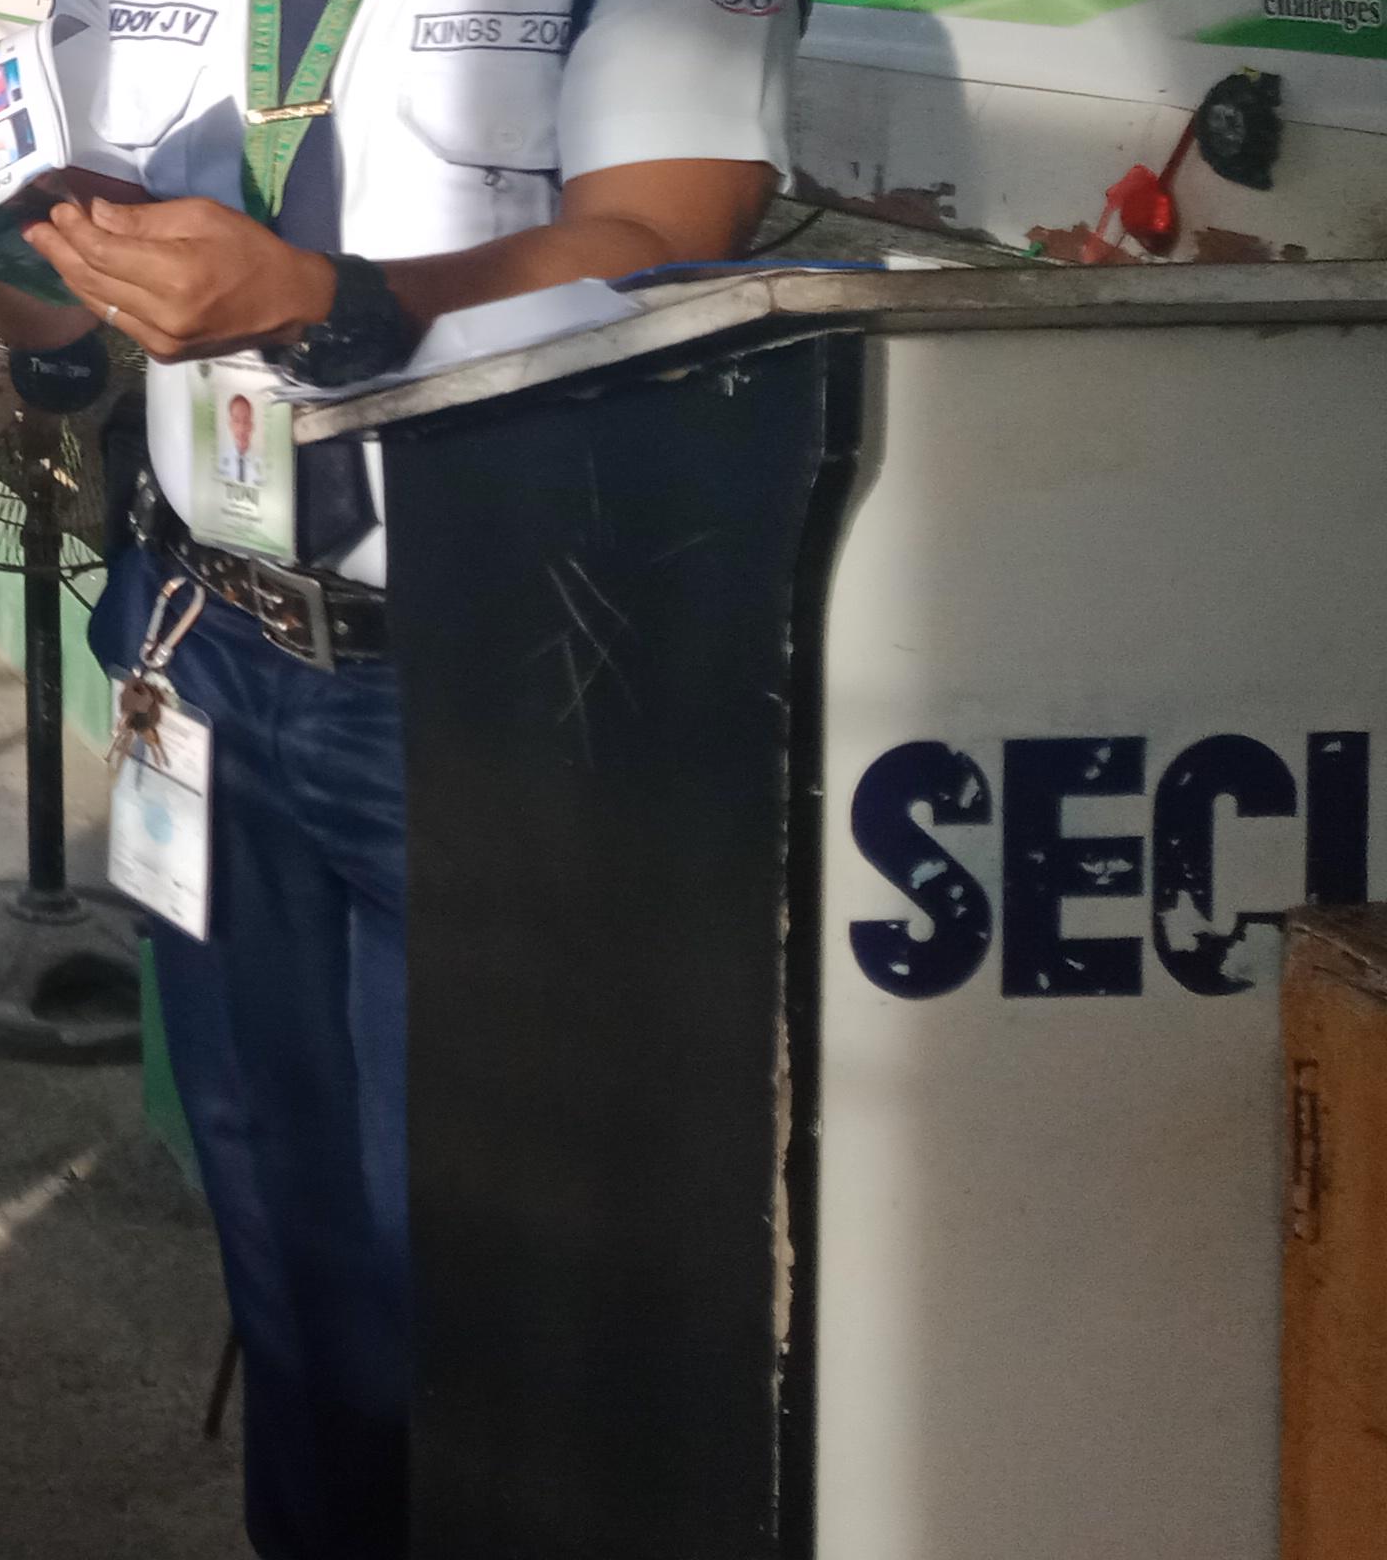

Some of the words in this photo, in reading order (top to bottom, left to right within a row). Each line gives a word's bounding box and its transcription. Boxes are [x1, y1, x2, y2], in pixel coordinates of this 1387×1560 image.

[160, 10, 181, 33] J
[183, 11, 203, 35] V
[419, 17, 503, 45] KINGS
